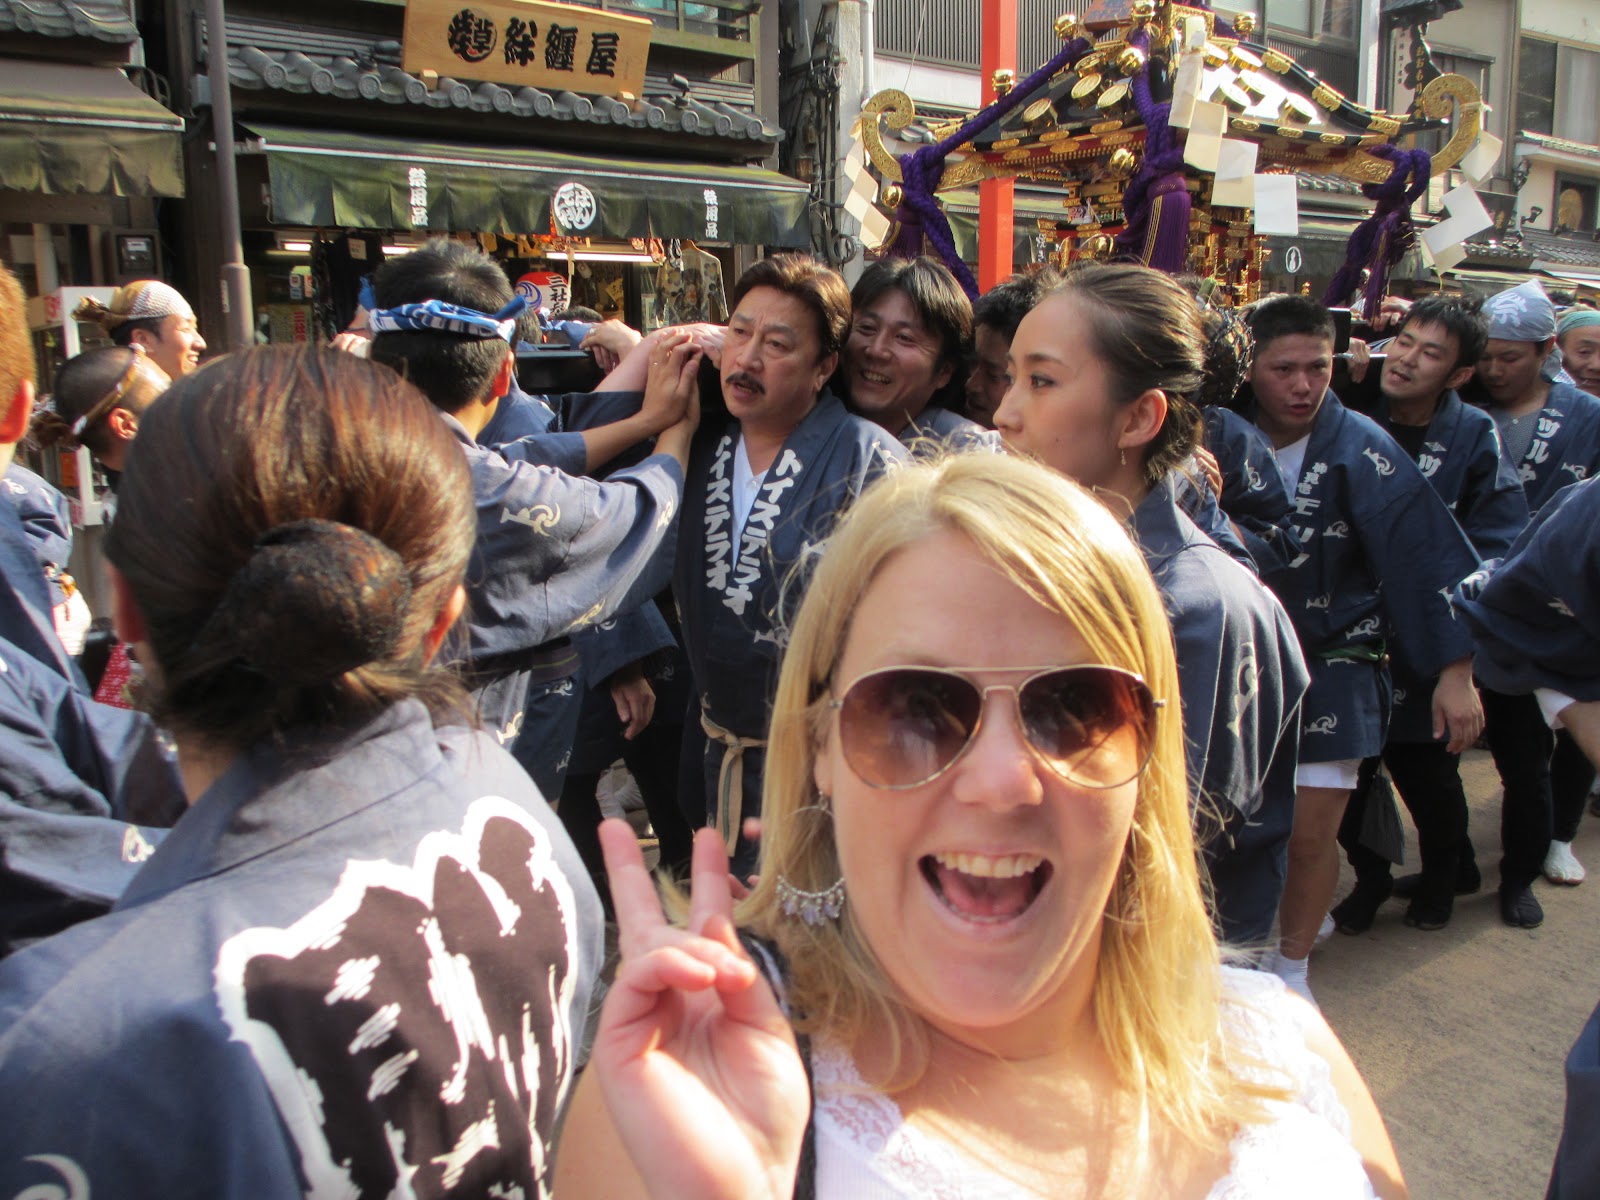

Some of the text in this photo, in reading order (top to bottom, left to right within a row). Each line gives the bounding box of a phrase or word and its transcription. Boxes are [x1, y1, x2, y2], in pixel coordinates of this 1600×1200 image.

[704, 435, 732, 591] トイステラオ
[722, 449, 803, 616] トイステラオ
